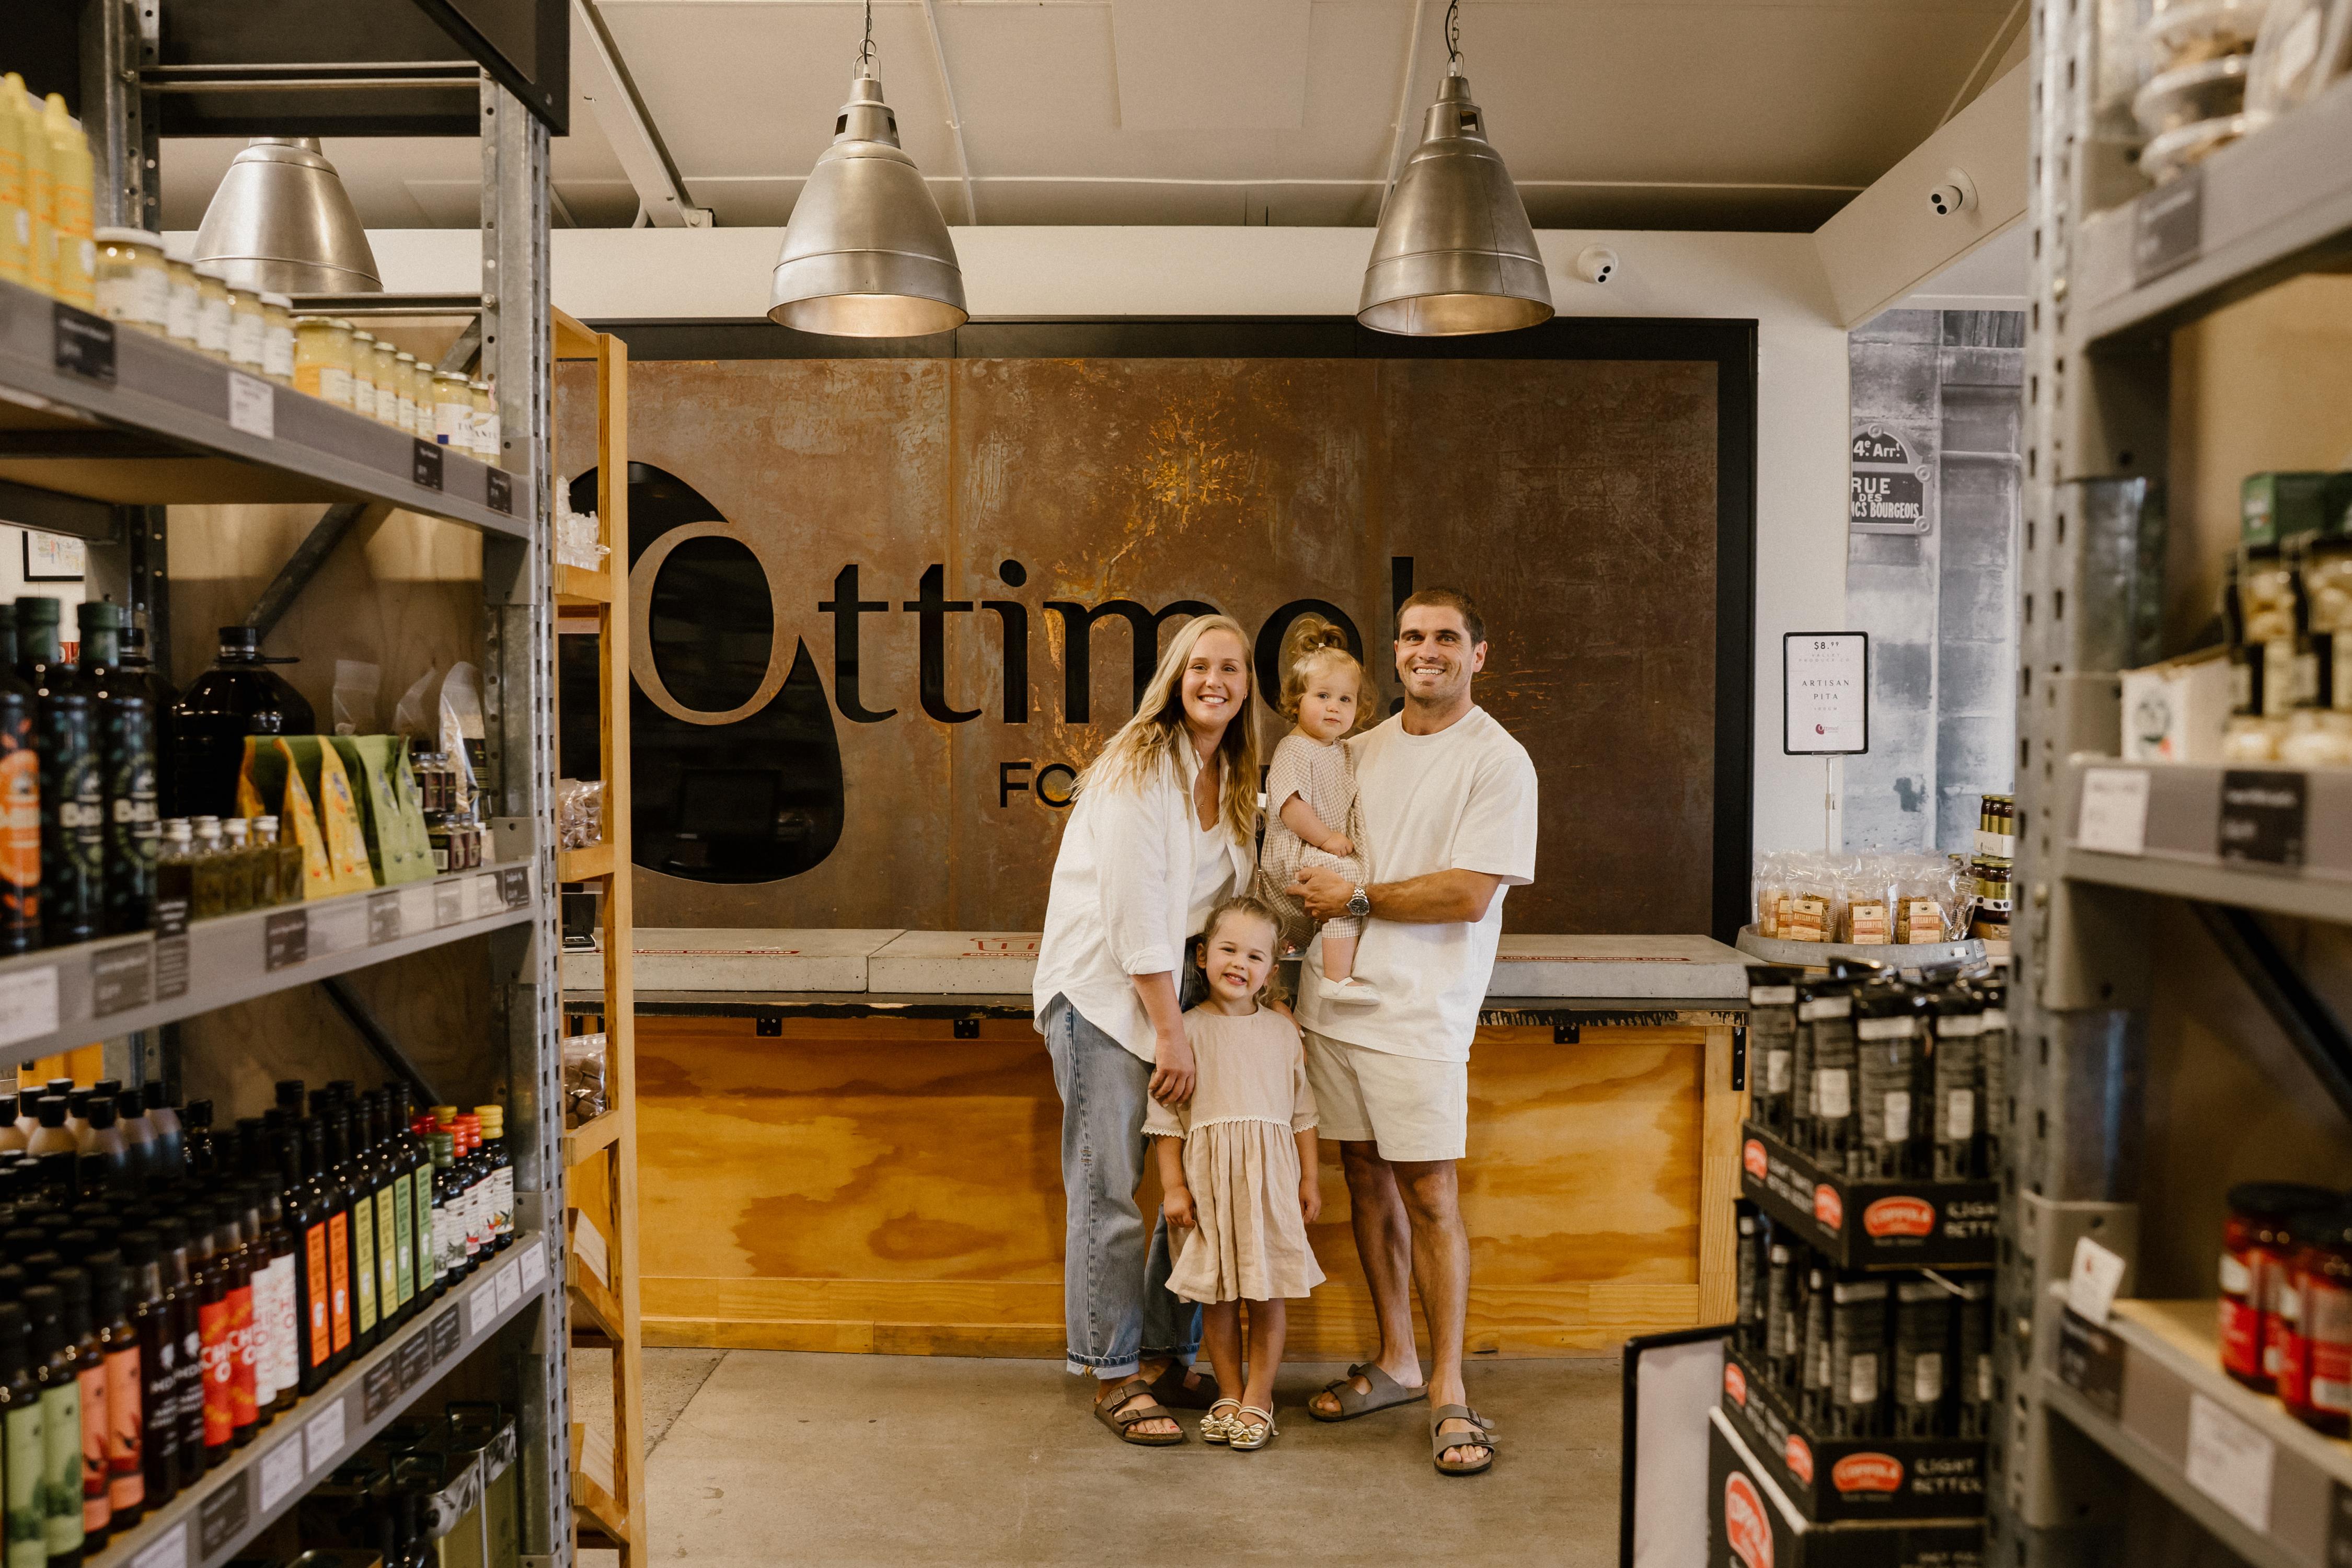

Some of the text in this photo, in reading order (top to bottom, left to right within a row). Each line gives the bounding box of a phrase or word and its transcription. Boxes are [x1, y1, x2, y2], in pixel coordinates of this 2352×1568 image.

[1852, 477, 1891, 494] RUE
[1859, 493, 1883, 502] DES
[1870, 502, 1920, 519] BOURGEOIS
[1814, 641, 1839, 650] $8.99
